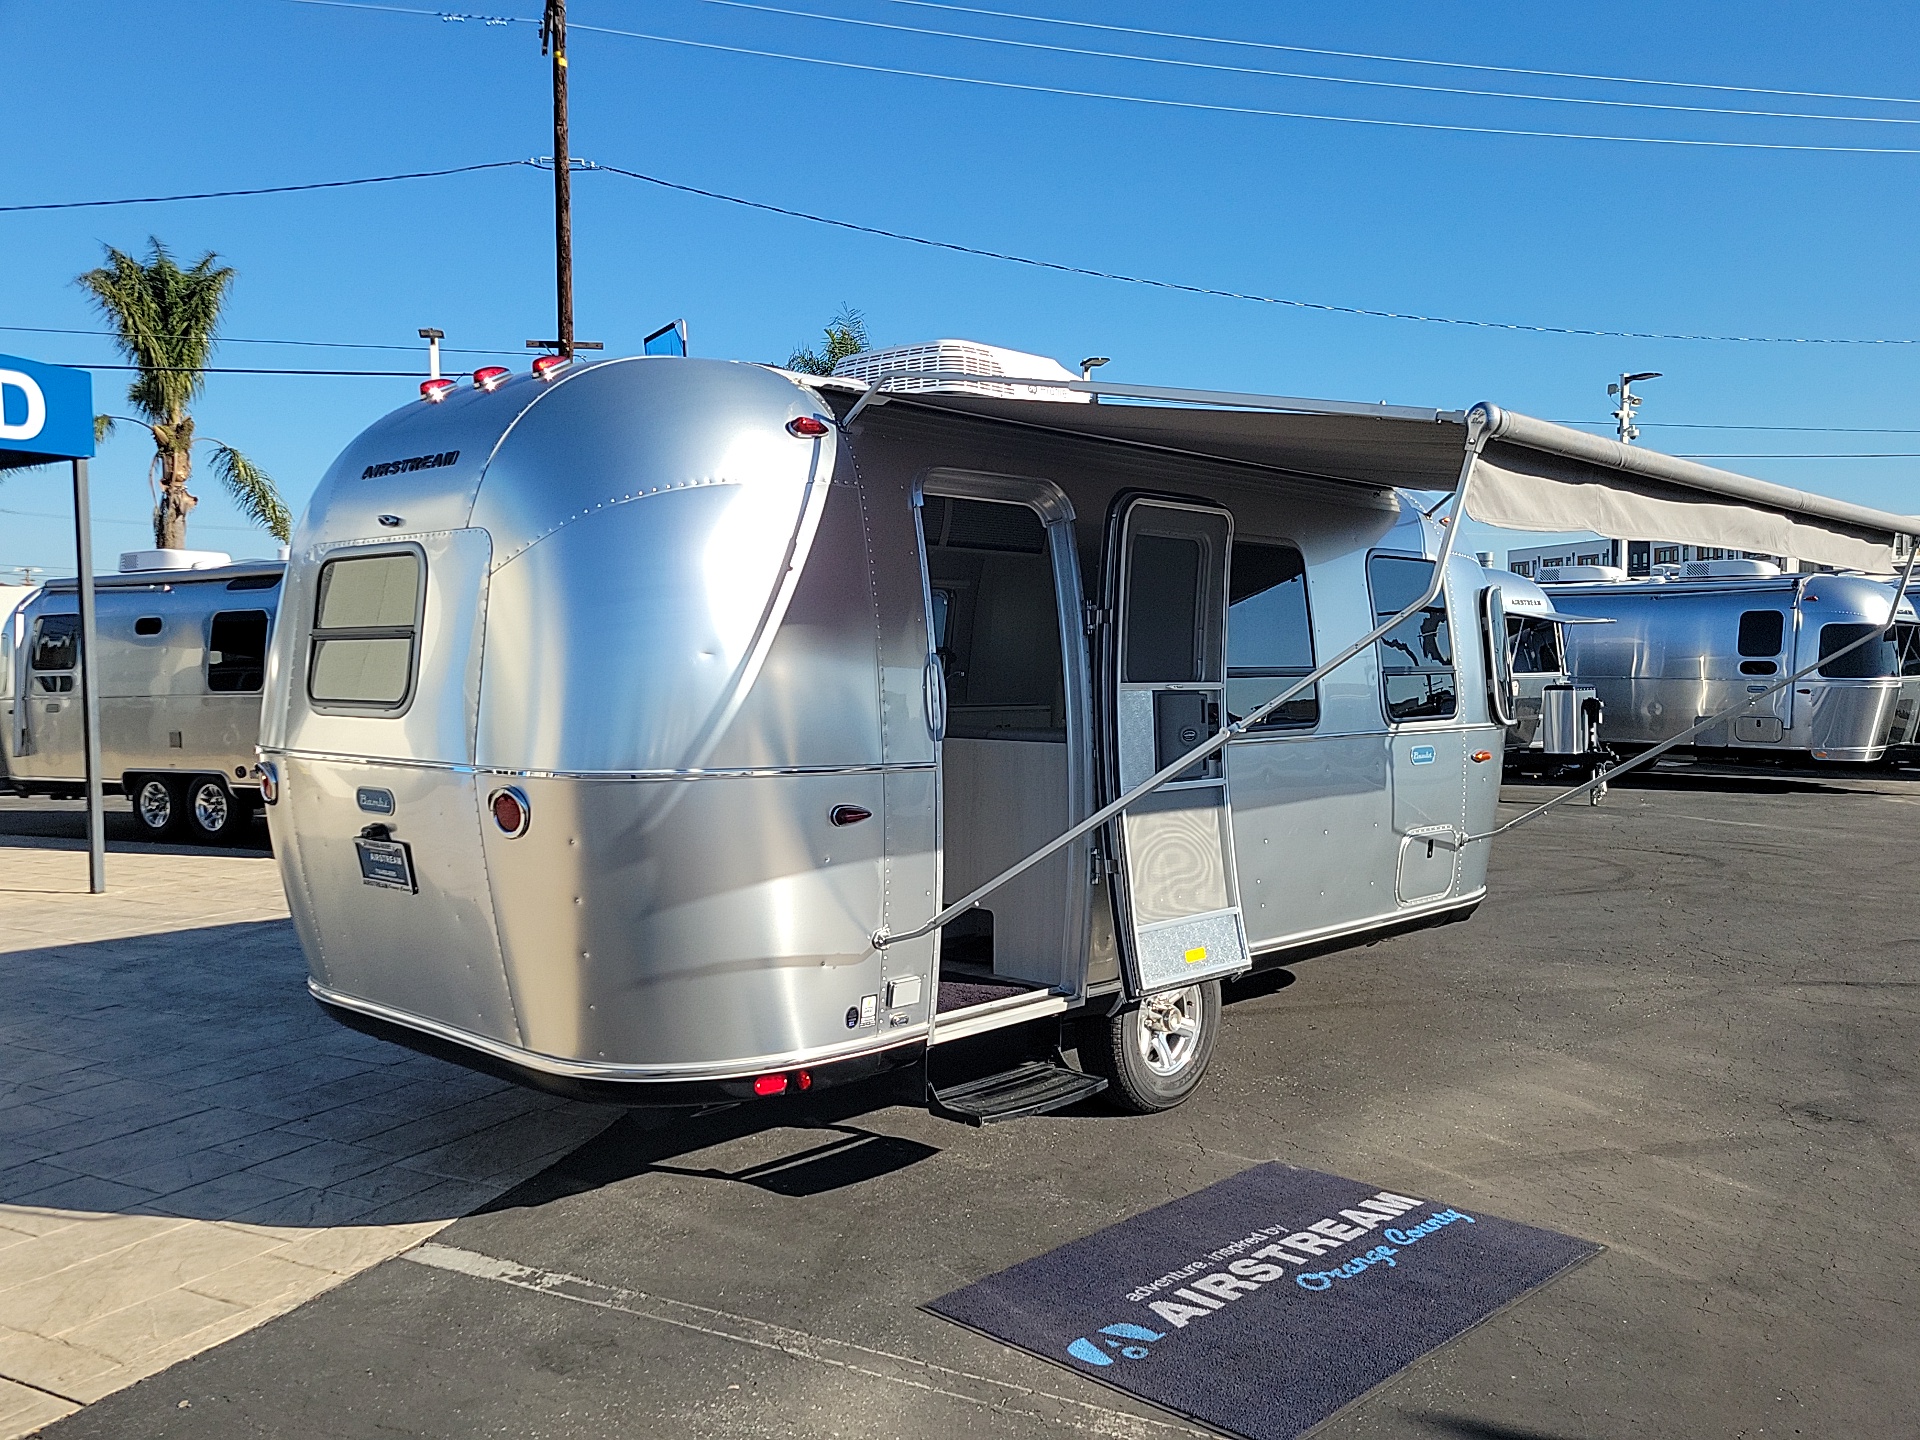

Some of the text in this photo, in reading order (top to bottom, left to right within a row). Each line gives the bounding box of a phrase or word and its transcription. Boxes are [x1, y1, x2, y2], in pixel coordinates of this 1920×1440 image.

[361, 450, 460, 480] AIRSTREAM
[360, 794, 390, 807] Bambi
[1148, 1191, 1425, 1329] AIRSTREAM
[1203, 1230, 1269, 1262] inspired
[1259, 1223, 1290, 1236] by
[1296, 1208, 1476, 1291] Orange County
